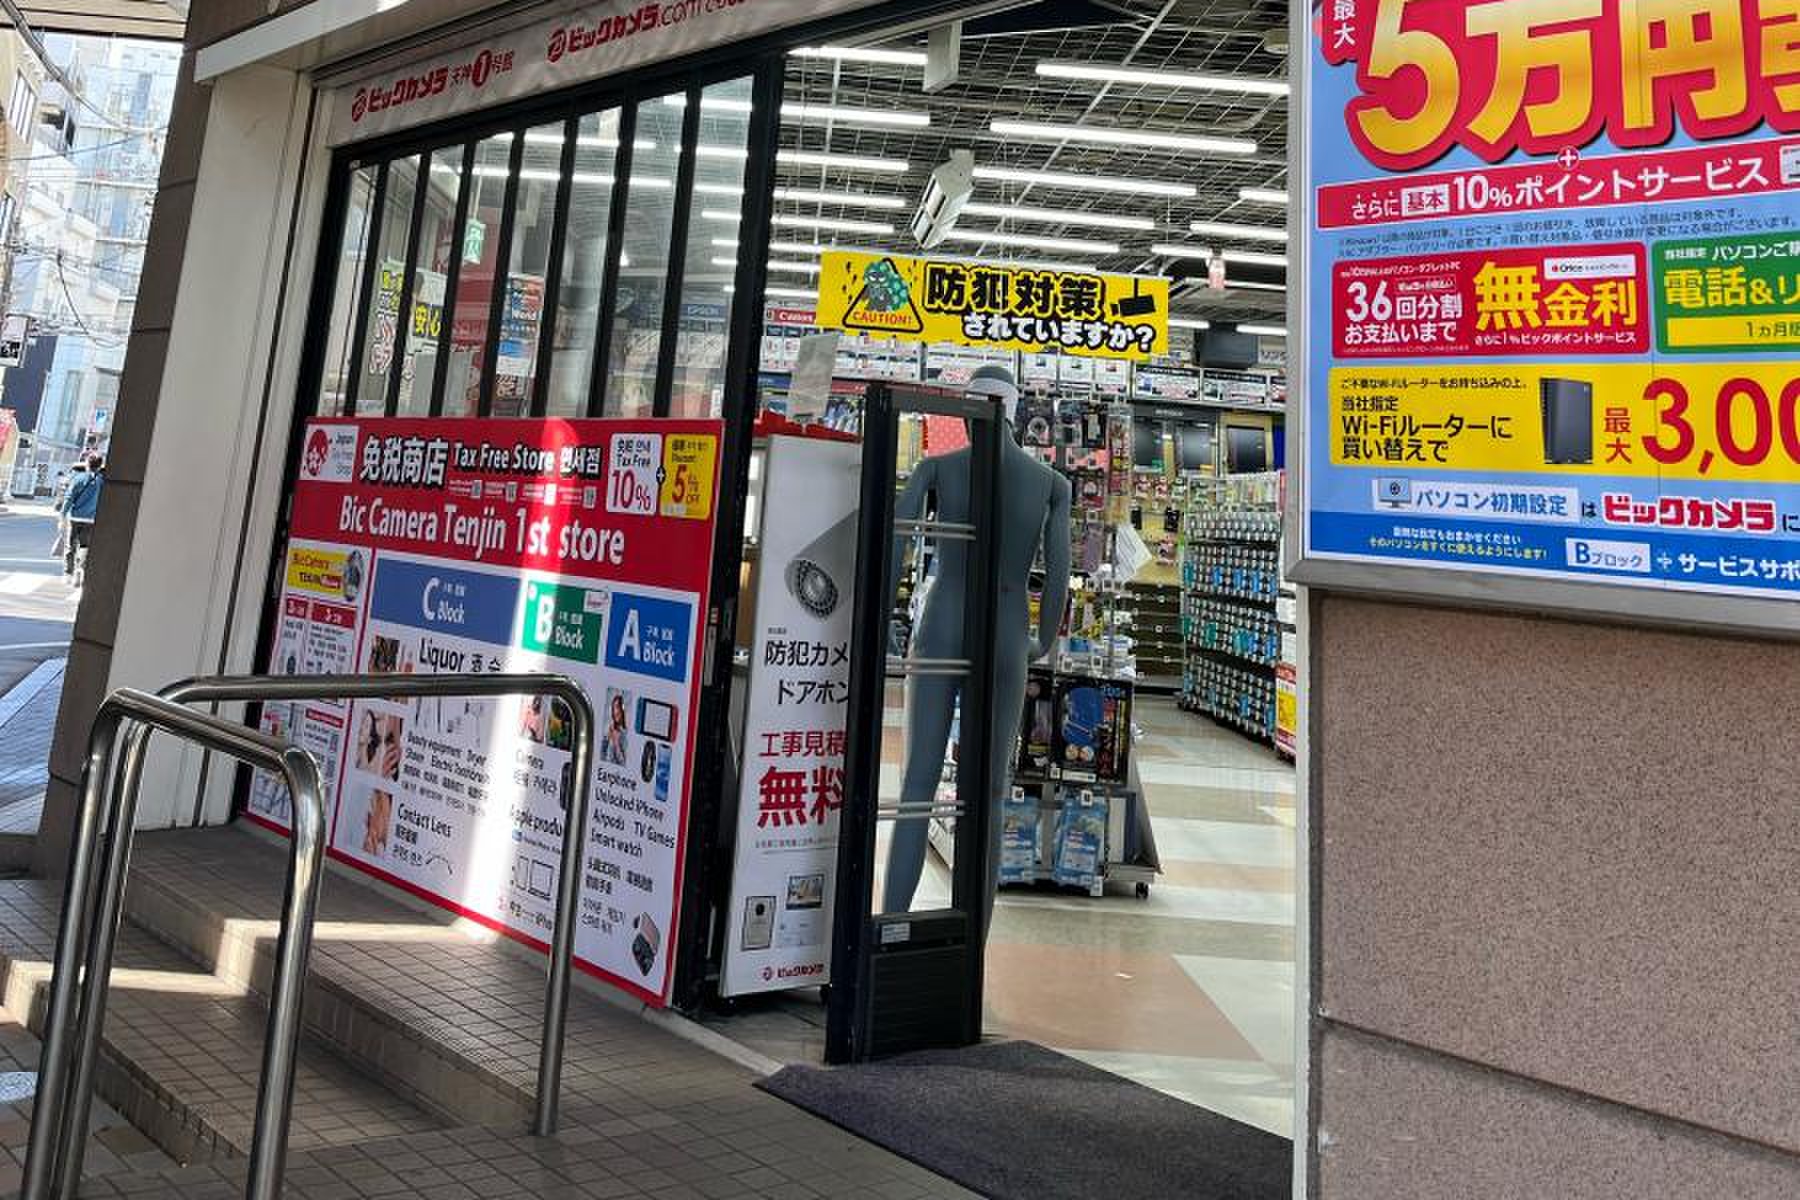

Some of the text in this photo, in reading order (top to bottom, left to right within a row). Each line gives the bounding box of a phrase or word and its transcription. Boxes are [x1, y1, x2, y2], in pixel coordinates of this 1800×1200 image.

[1453, 156, 1768, 211] 10%ポイントサービス
[926, 265, 1102, 318] 防犯対策
[1345, 280, 1462, 322] 36回分割
[1473, 261, 1637, 331] 無金利
[852, 310, 913, 327] CAUTION!
[964, 312, 1153, 350] されていますか?
[1344, 321, 1457, 345] お支払いまで
[1342, 414, 1513, 438] Wi-Fiルーターに
[1606, 408, 1632, 464] 最大
[454, 442, 555, 471] Tax Free Store
[1342, 438, 1449, 462] 買い替えで
[612, 470, 651, 511] 10%
[1417, 490, 1568, 516] パソコン初期設定
[1604, 495, 1774, 531] ビックカメラ
[340, 496, 626, 566] Bic Camera Tenjin 1st store
[423, 577, 439, 620] C
[535, 595, 555, 642] B
[555, 625, 584, 649] Block
[617, 608, 674, 667] A Block
[420, 637, 465, 673] Liquor
[765, 640, 848, 666] 防犯カメ
[535, 819, 561, 837] produ
[634, 821, 646, 837] TV
